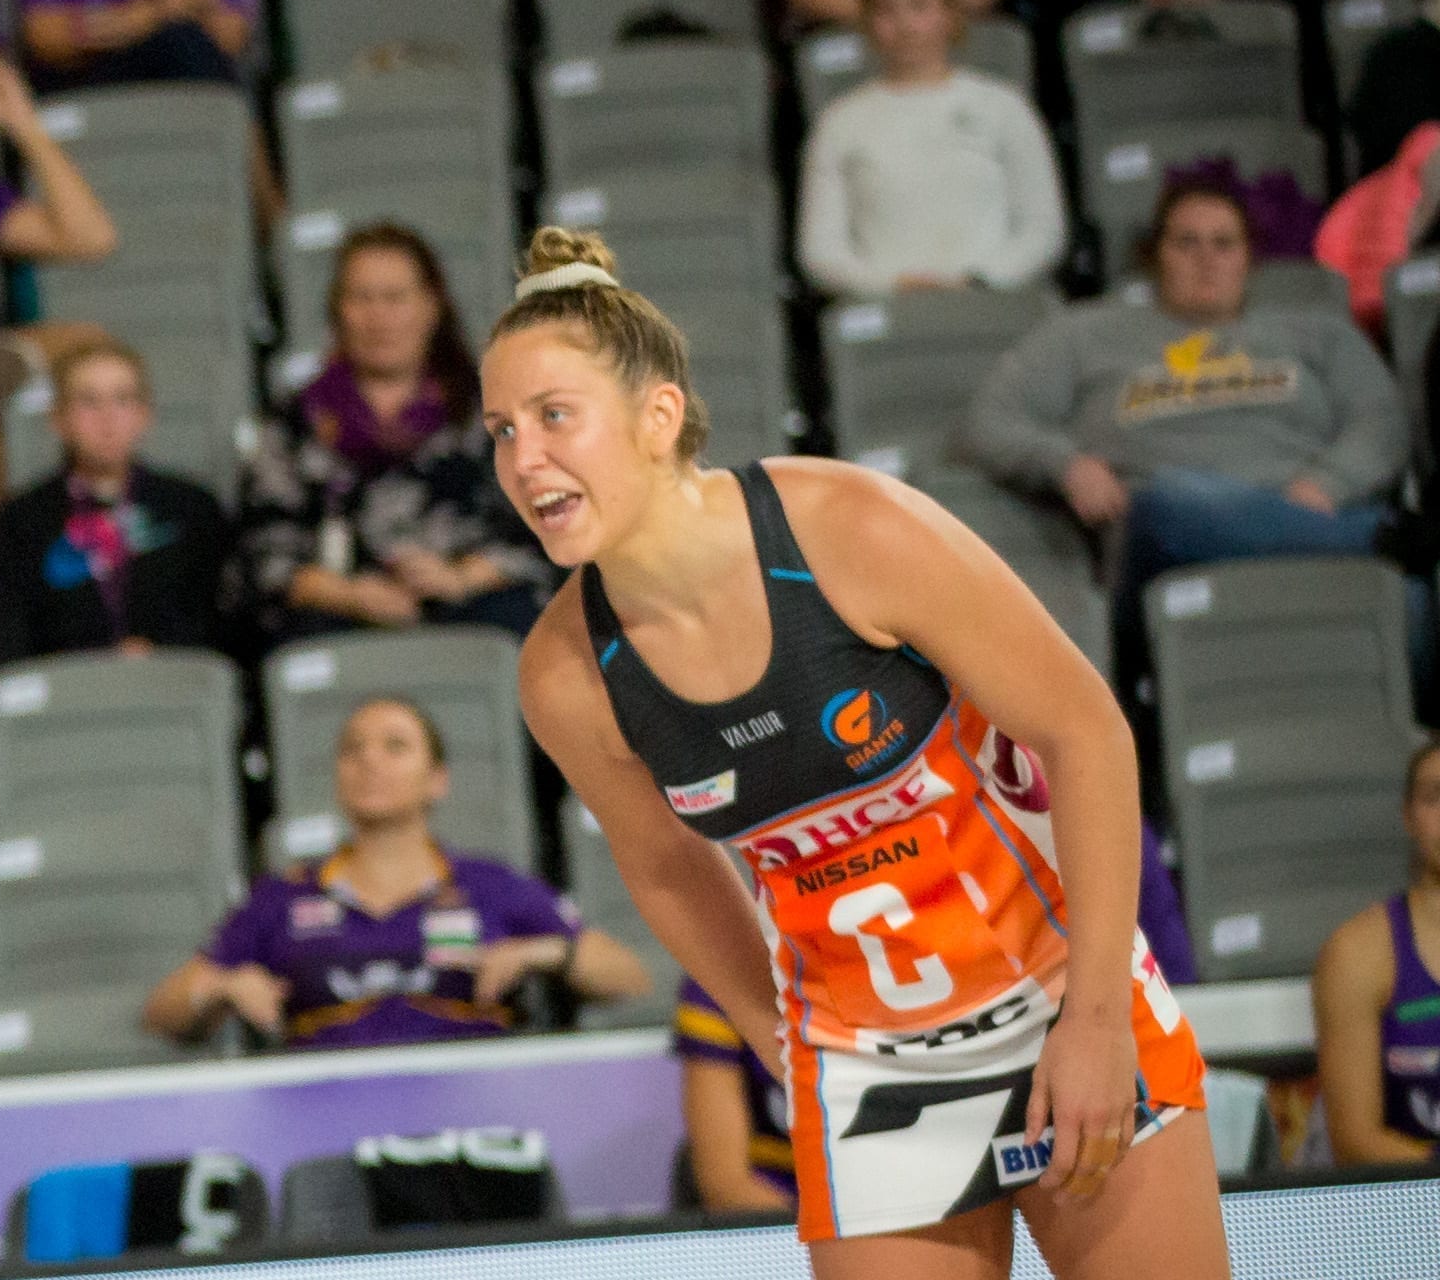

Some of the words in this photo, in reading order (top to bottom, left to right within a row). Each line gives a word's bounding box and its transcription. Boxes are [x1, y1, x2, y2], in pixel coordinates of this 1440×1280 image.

[720, 710, 786, 749] VALOUR
[846, 719, 904, 769] GIANTS
[795, 837, 920, 897] NISSAN
[828, 882, 955, 1011] C
